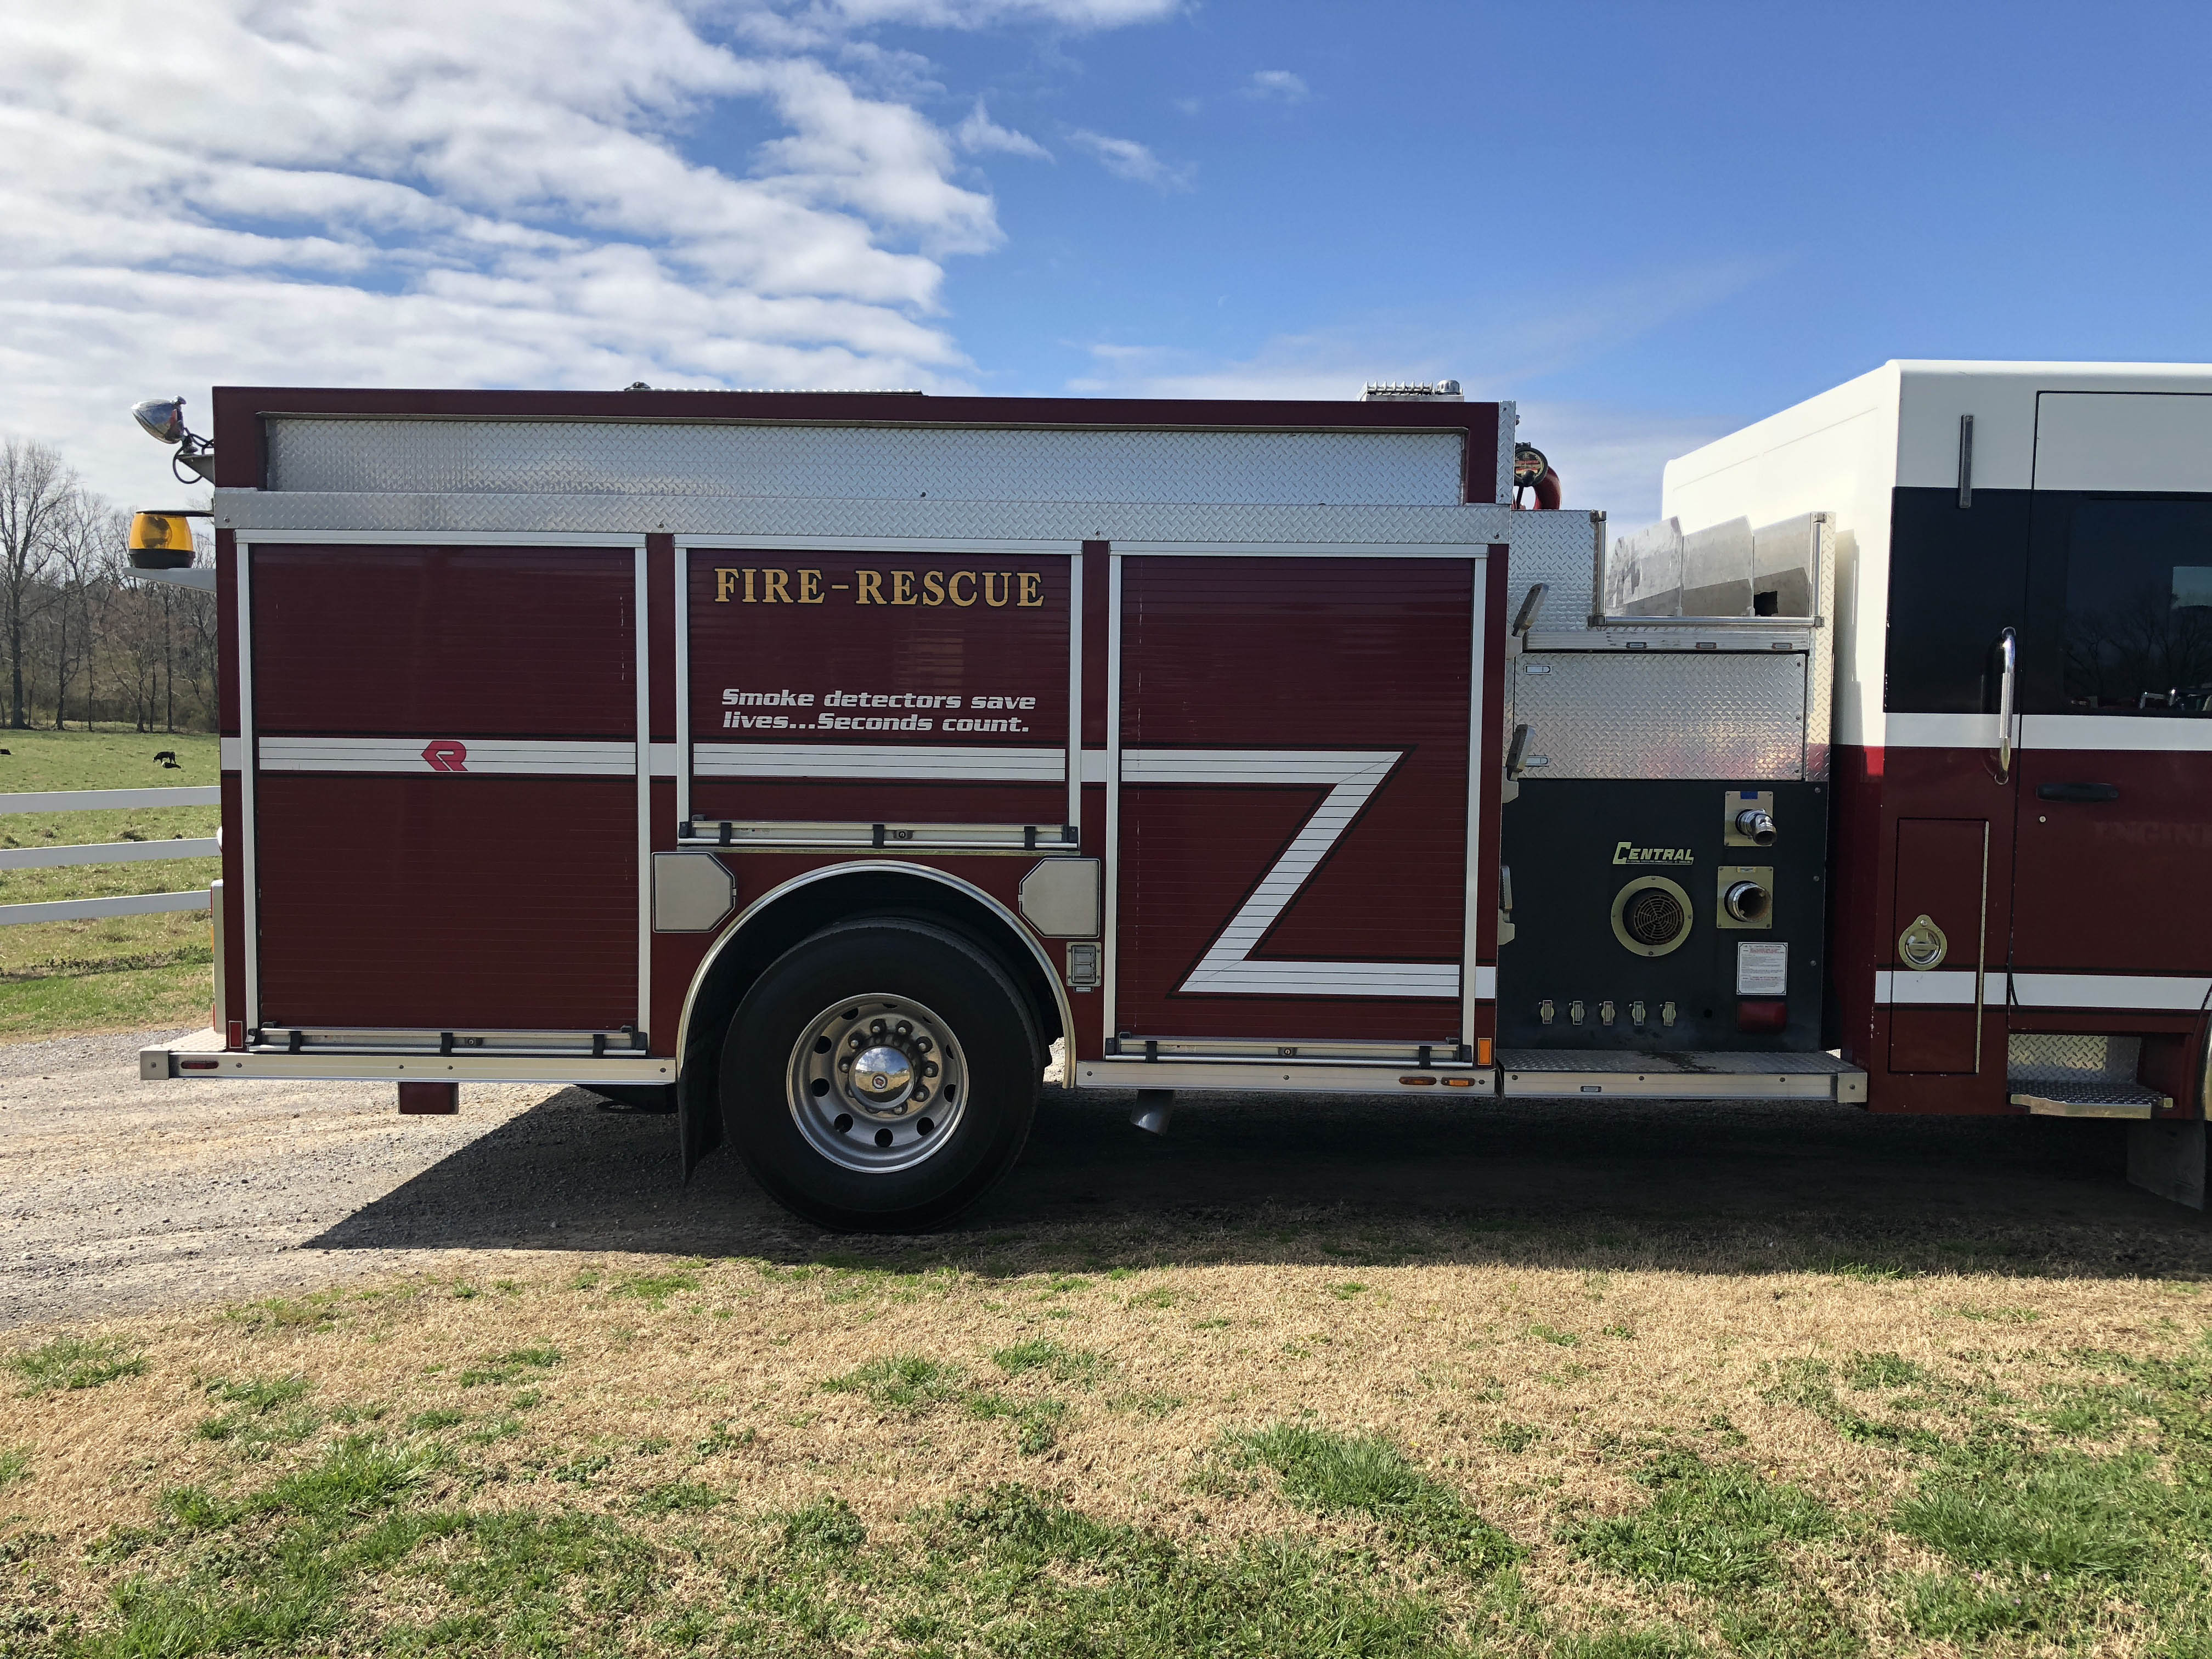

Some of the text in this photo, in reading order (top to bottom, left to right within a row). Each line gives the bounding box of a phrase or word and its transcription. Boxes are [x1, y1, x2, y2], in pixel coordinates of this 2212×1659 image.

[721, 688, 1036, 710] Smoke detectors save
[942, 716, 1030, 733] count.
[1612, 842, 1694, 865] CENTRAL
